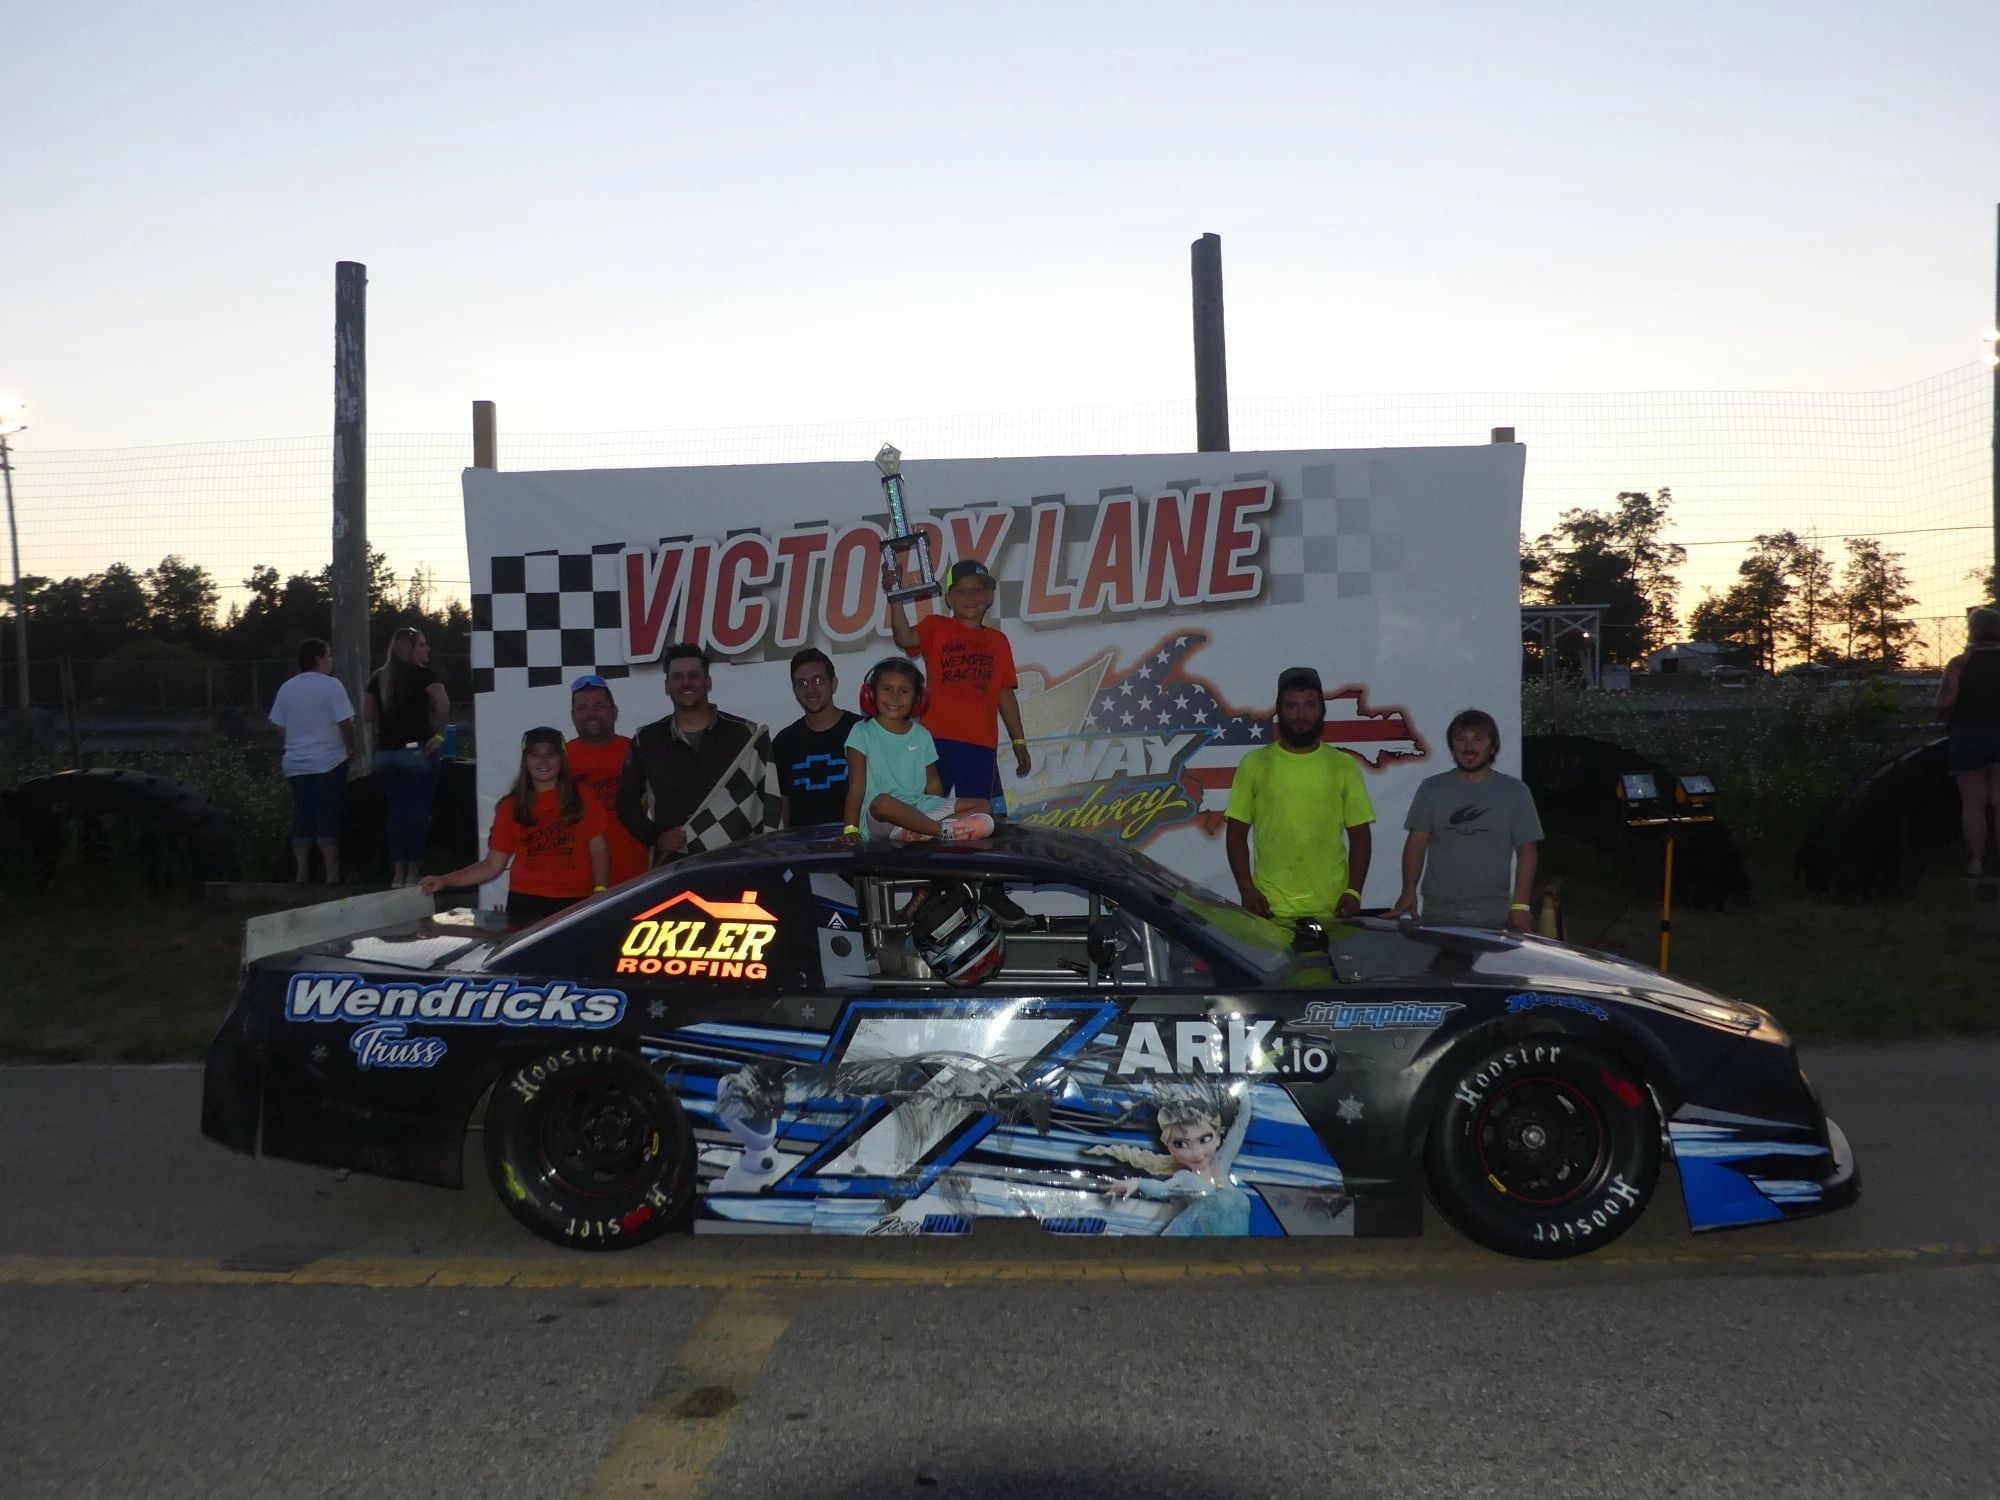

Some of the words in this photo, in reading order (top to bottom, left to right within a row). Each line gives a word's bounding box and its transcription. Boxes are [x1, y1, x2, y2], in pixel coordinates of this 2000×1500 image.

[1023, 482, 1270, 618] LANE
[621, 920, 777, 961] OKLER
[616, 957, 768, 980] ROOFING
[289, 977, 623, 1023] Wendricks
[352, 1024, 444, 1068] Truss
[510, 1044, 618, 1104] Hoosier
[1454, 1041, 1562, 1112] Hoosier
[1532, 1173, 1642, 1243] Hoosier
